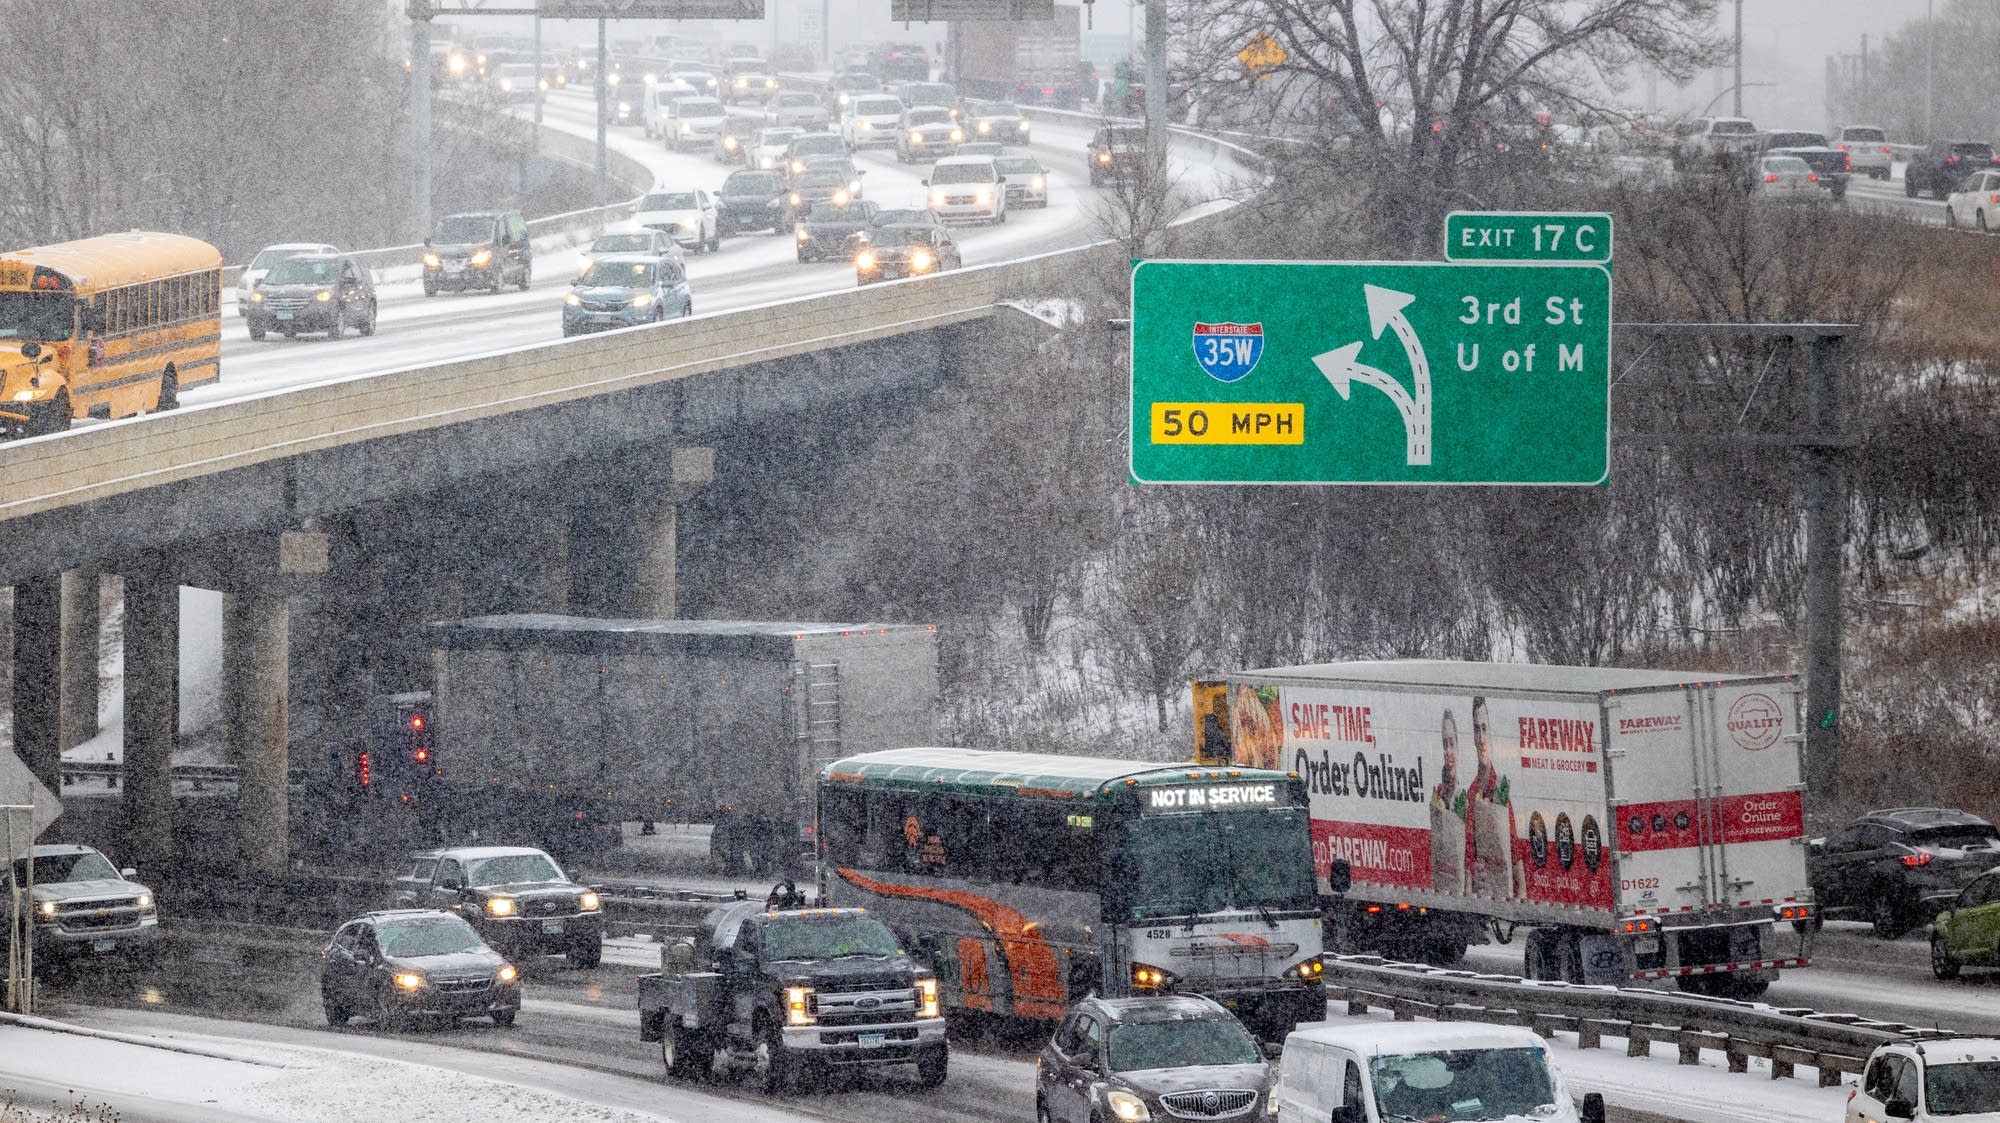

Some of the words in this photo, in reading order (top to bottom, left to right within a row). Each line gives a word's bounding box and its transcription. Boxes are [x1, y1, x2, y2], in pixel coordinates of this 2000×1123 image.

[1462, 228, 1515, 246] EXIT
[1532, 225, 1565, 251] 17
[1575, 225, 1595, 252] C
[1459, 296, 1520, 324] 3rd
[1545, 296, 1583, 325] St
[1209, 326, 1248, 334] INTERSTATE
[1204, 338, 1253, 366] 35W
[1457, 343, 1479, 371] U
[1502, 343, 1536, 371] of
[1559, 344, 1583, 371] M
[1163, 410, 1209, 436] 50
[1232, 413, 1293, 434] MPH
[1292, 702, 1331, 739] SAVE
[1332, 705, 1377, 751] TIME,
[1619, 715, 1681, 729] FAREWAY
[1727, 717, 1783, 732] QUALITY
[1518, 716, 1594, 753] FAREWAY
[1295, 748, 1350, 796] Order
[1353, 751, 1425, 803] Online!
[1531, 757, 1549, 769] MEAT
[1556, 759, 1586, 773] GROCERY
[1152, 789, 1187, 807] NOT
[1189, 788, 1205, 805] IN
[1208, 785, 1275, 804] SERVICE
[1743, 800, 1778, 812] Order
[1741, 811, 1781, 823] Online
[1312, 835, 1414, 873] op.FAREWAY.com
[1621, 878, 1659, 891] D1622
[1146, 930, 1171, 939] 4528
